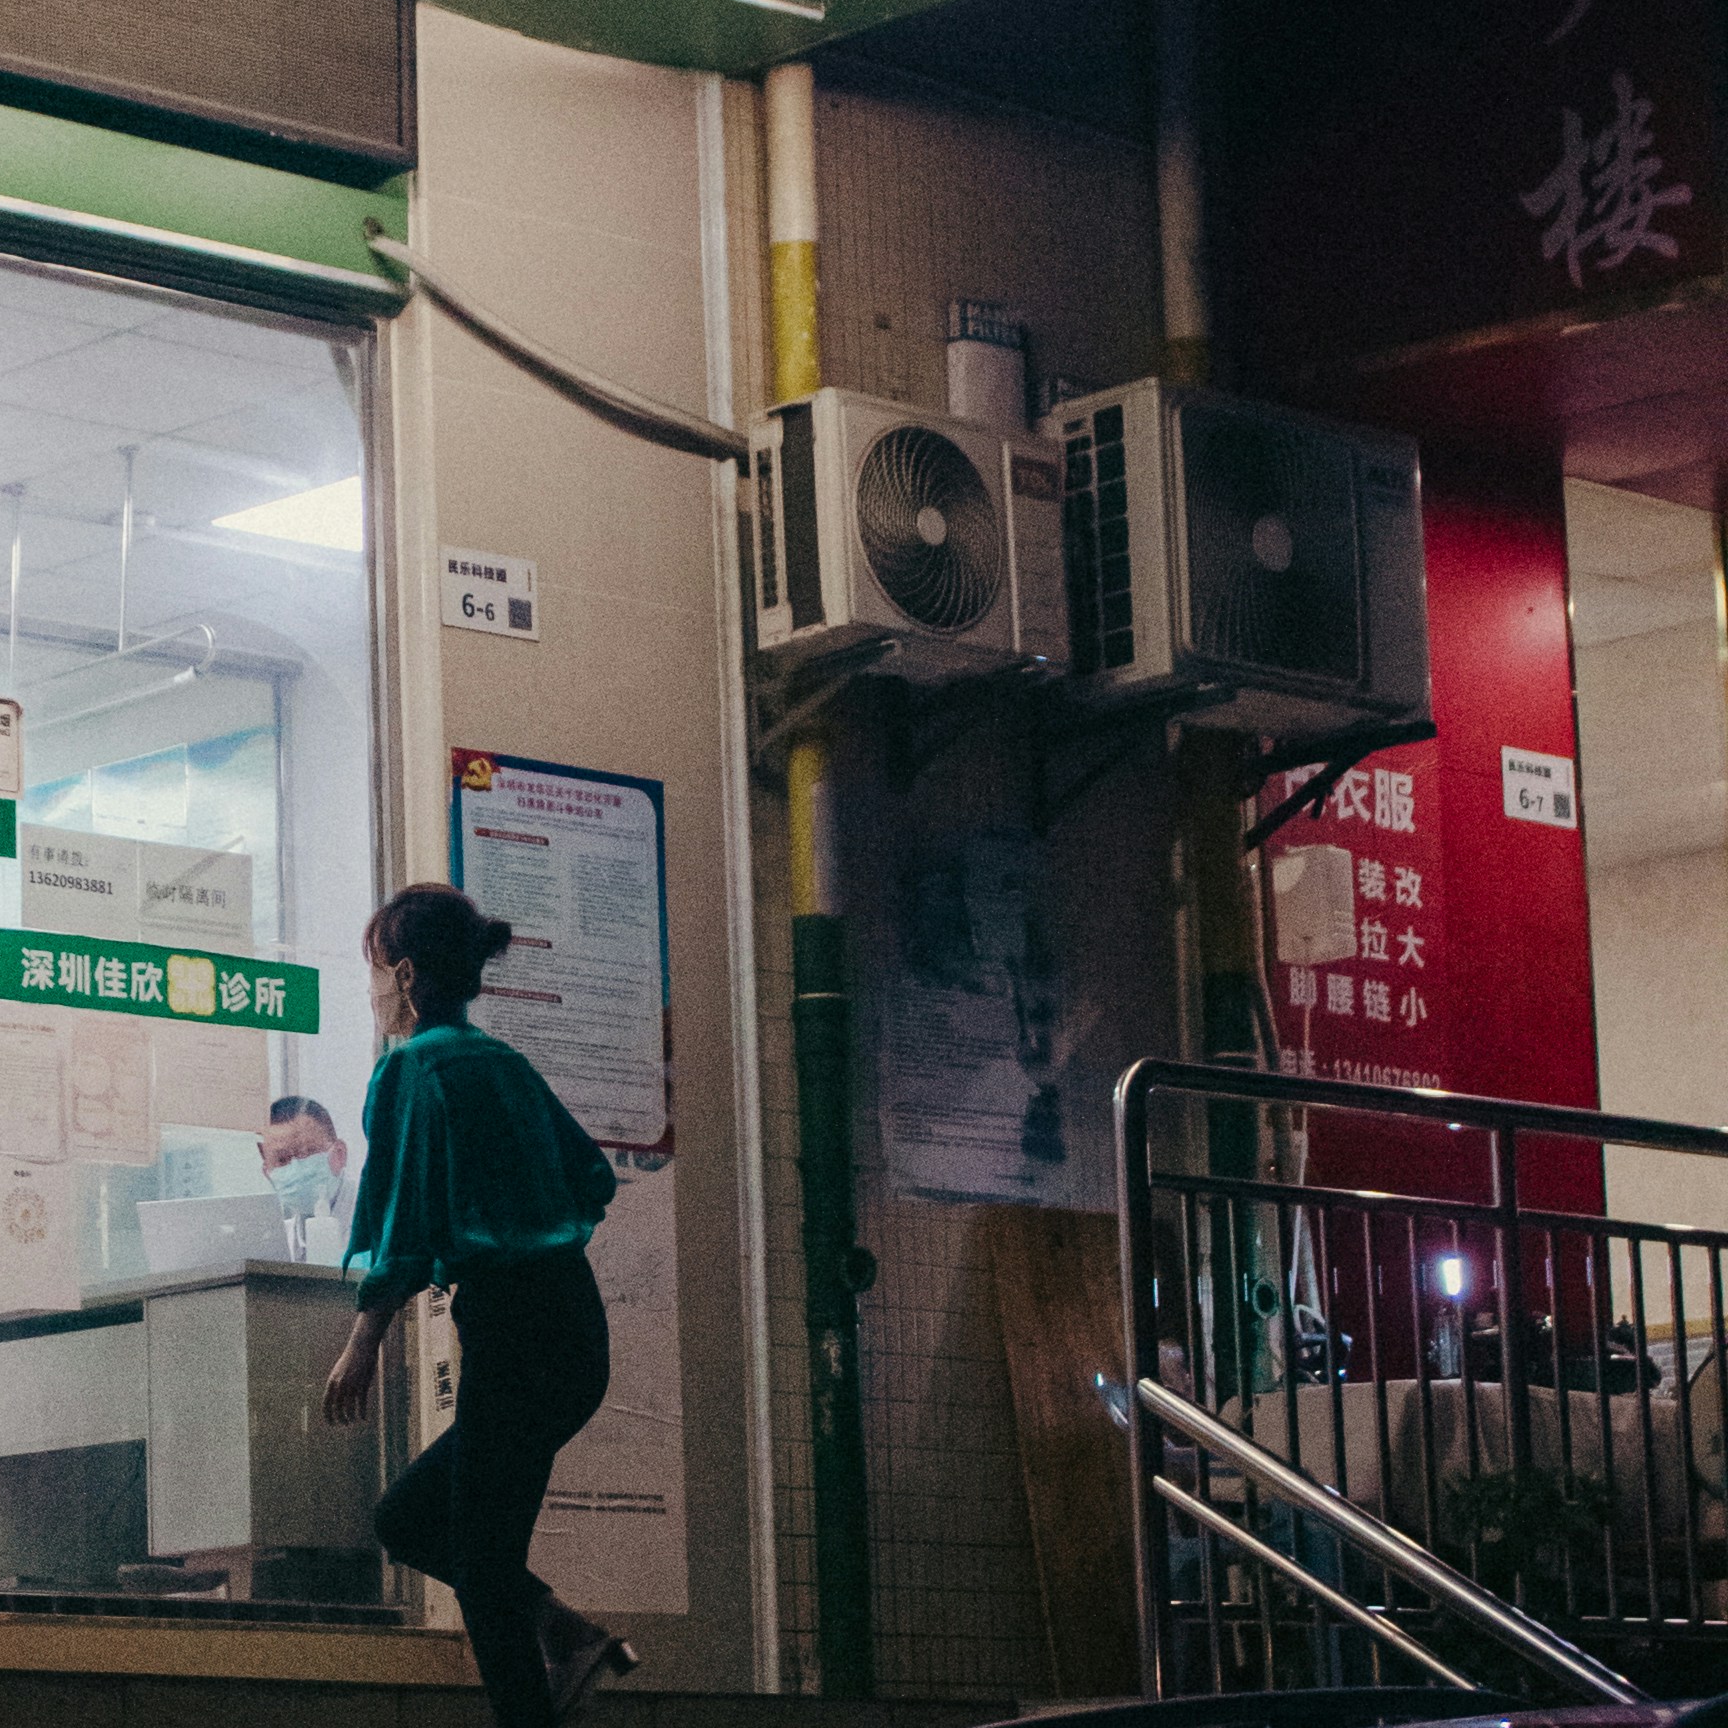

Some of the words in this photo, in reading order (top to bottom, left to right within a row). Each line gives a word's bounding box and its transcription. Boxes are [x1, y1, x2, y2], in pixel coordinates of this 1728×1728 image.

[461, 592, 496, 621] 6-6
[1519, 787, 1544, 813] 6-7
[20, 947, 164, 1004] 深圳佳欣
[218, 971, 287, 1018] 诊所
